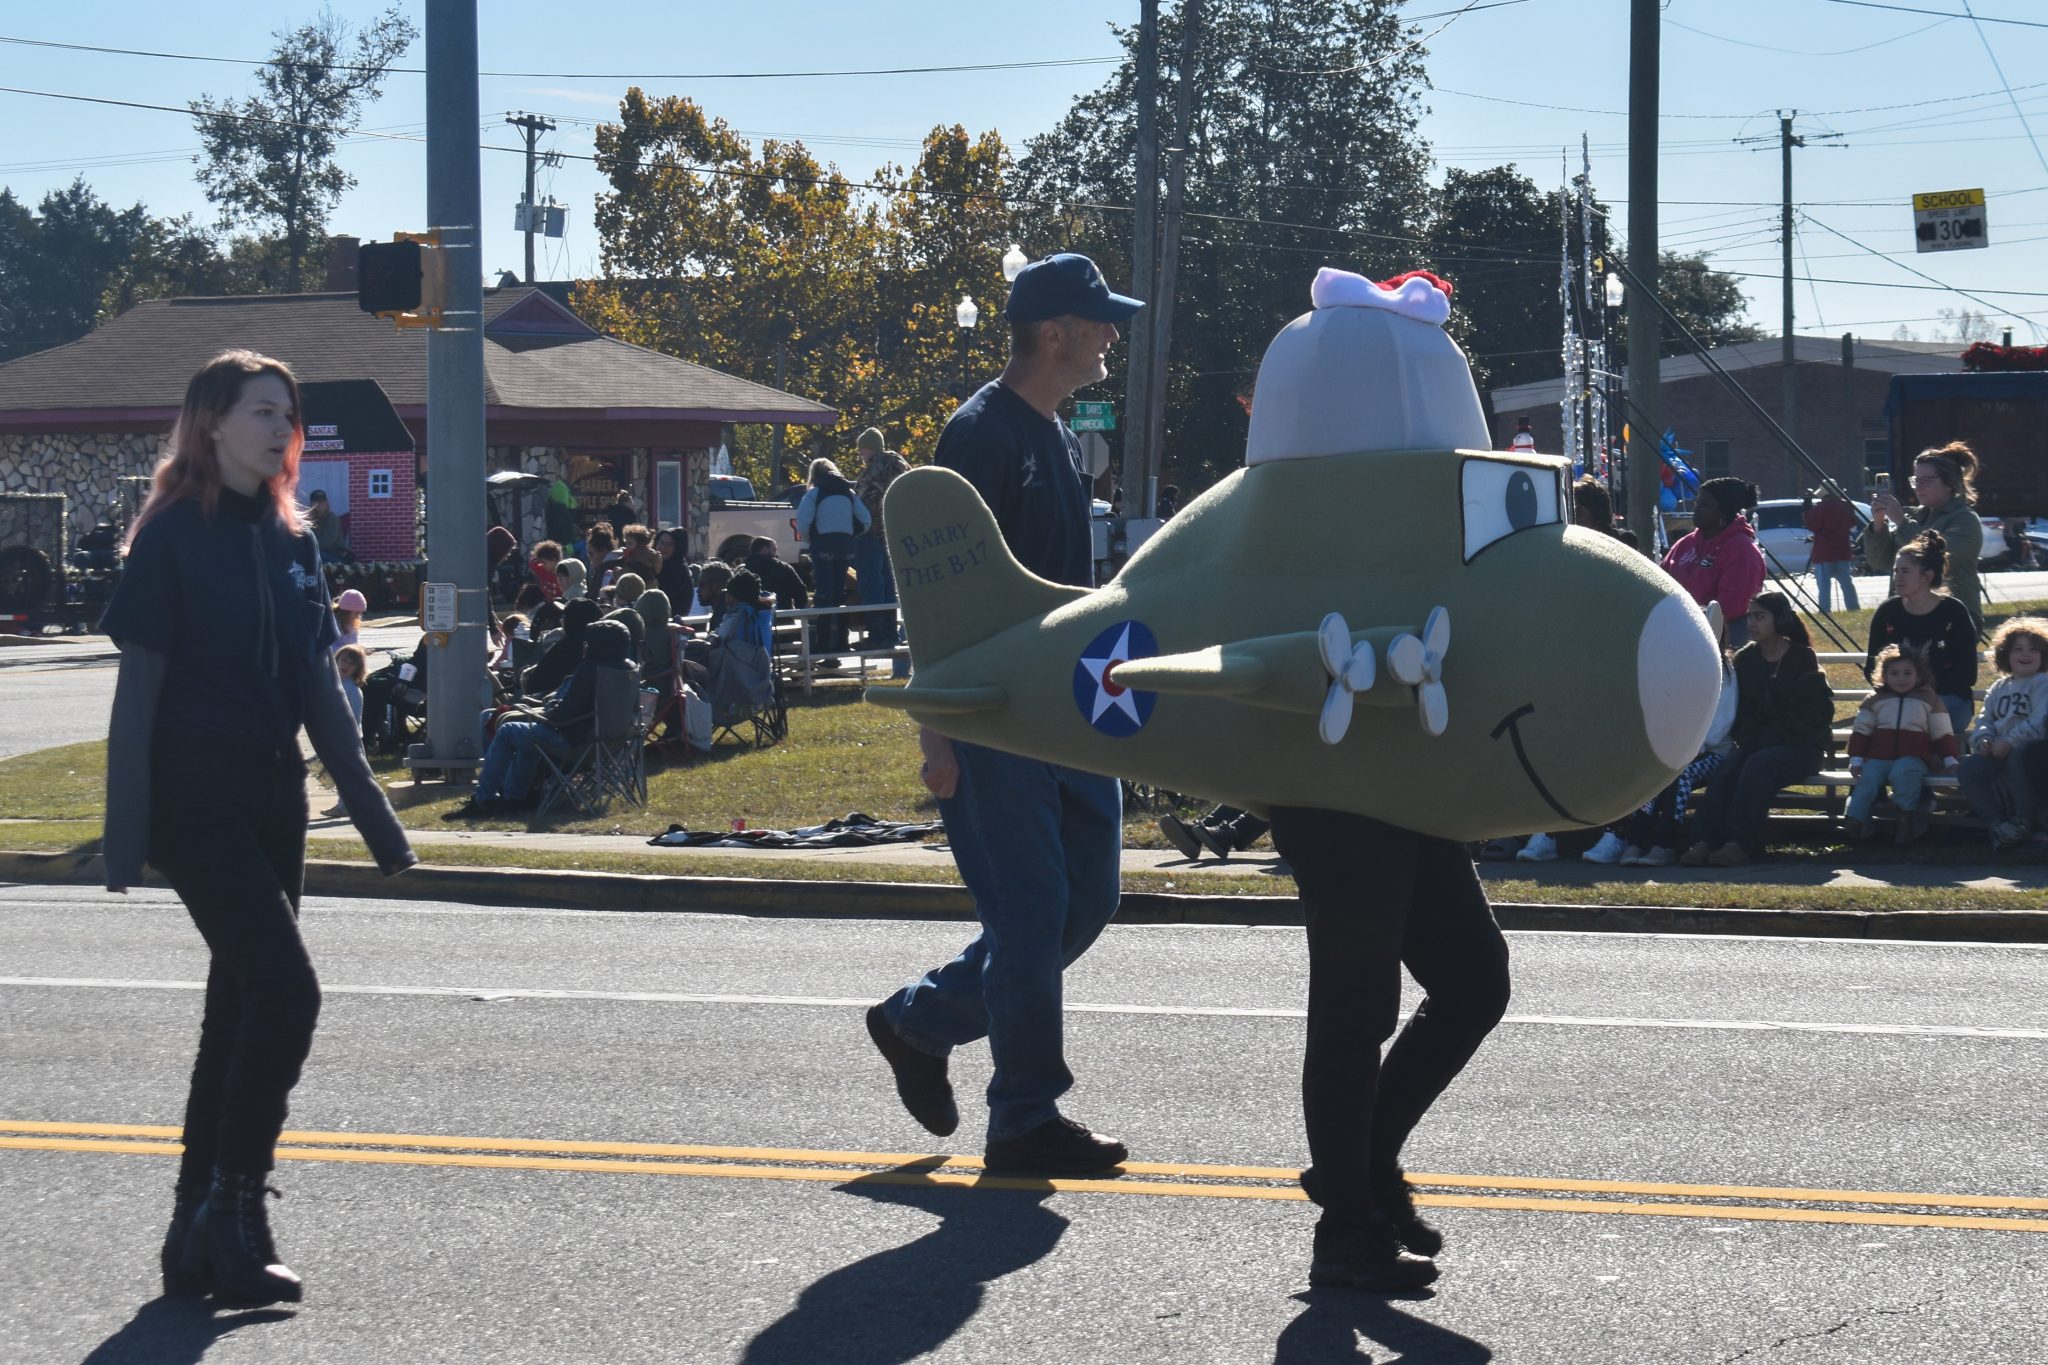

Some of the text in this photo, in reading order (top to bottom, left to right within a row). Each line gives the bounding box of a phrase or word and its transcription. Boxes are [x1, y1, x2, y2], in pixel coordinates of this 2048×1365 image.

[1921, 191, 1976, 208] SCHOOL
[1927, 207, 1971, 218] SPEED LIMIT
[1940, 219, 1962, 241] 30
[1086, 404, 1103, 415] DAVIS
[1076, 418, 1105, 430] COMMERCIAL
[303, 440, 344, 450] WORKSHOP
[580, 480, 613, 493] BARBER
[901, 522, 969, 558] BARRY
[901, 540, 988, 587] THE B-17
